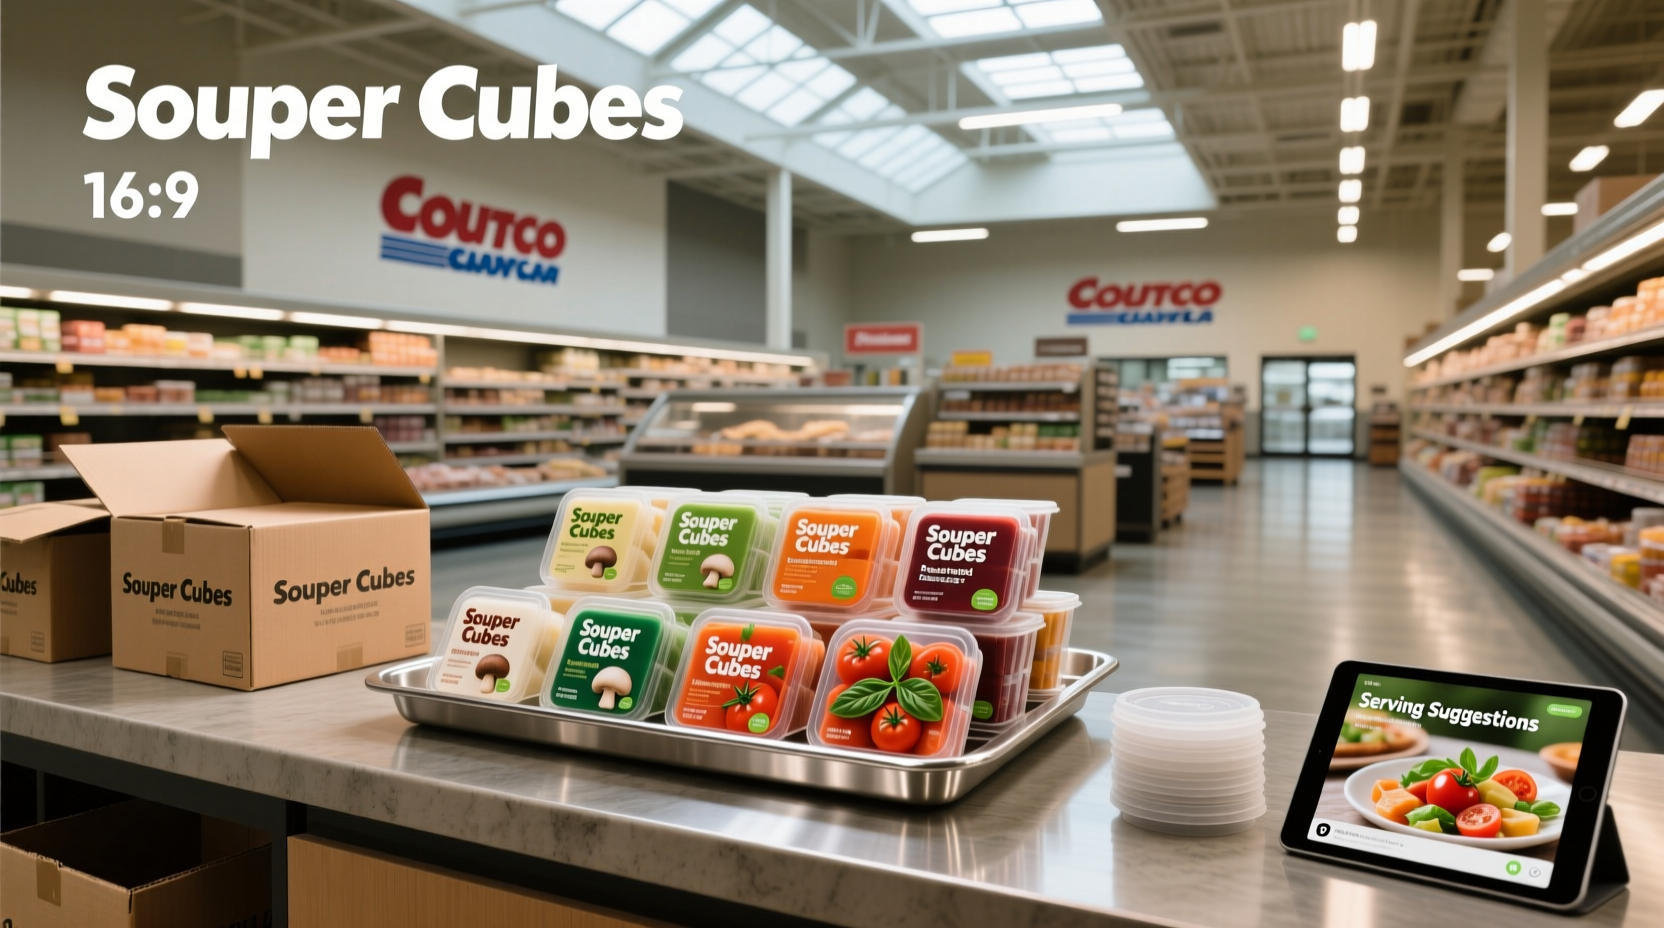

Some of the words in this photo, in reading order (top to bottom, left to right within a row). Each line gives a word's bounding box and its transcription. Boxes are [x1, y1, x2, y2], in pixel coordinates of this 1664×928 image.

[570, 507, 623, 526] Souper
[678, 511, 738, 533] Souper
[569, 523, 615, 540] Cubes
[678, 528, 729, 547] Cubes
[795, 518, 859, 539] Souper
[926, 524, 997, 546] Souper
[795, 536, 850, 555] Cubes
[927, 543, 987, 563] Cubes
[122, 571, 178, 603] Souper
[180, 578, 233, 607] Cubes
[273, 578, 352, 606] Souper
[355, 566, 416, 593] Cubes
[463, 607, 521, 630] Souper
[461, 626, 510, 647] Cubes
[579, 618, 642, 644] Souper
[577, 637, 631, 660] Cubes
[705, 635, 773, 661] Souper
[704, 655, 762, 679] Cubes
[1358, 691, 1425, 719] Serving
[1427, 701, 1540, 733] Suggestions
